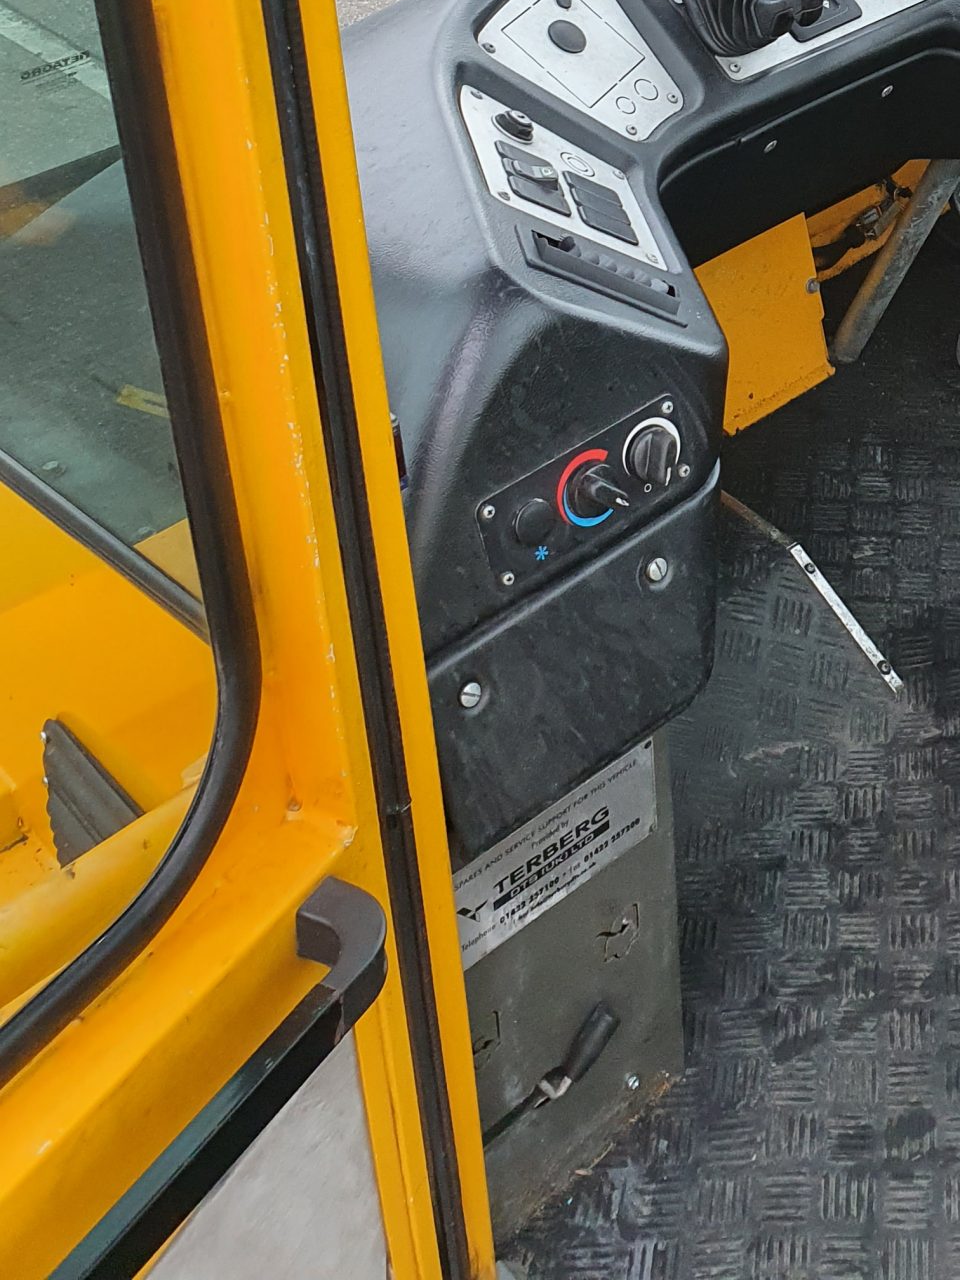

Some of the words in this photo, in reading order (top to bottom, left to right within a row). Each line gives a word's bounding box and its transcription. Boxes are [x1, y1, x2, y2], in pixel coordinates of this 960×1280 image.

[454, 869, 483, 890] SPARES
[484, 853, 503, 871] AND
[504, 831, 535, 856] SERVICE
[537, 806, 572, 832] SUPPORT
[573, 793, 588, 809] FOR
[590, 782, 606, 795] THIS
[493, 805, 610, 895] TERBERG
[559, 818, 570, 832] by
[510, 874, 539, 899] DTS
[569, 832, 596, 857] LTD
